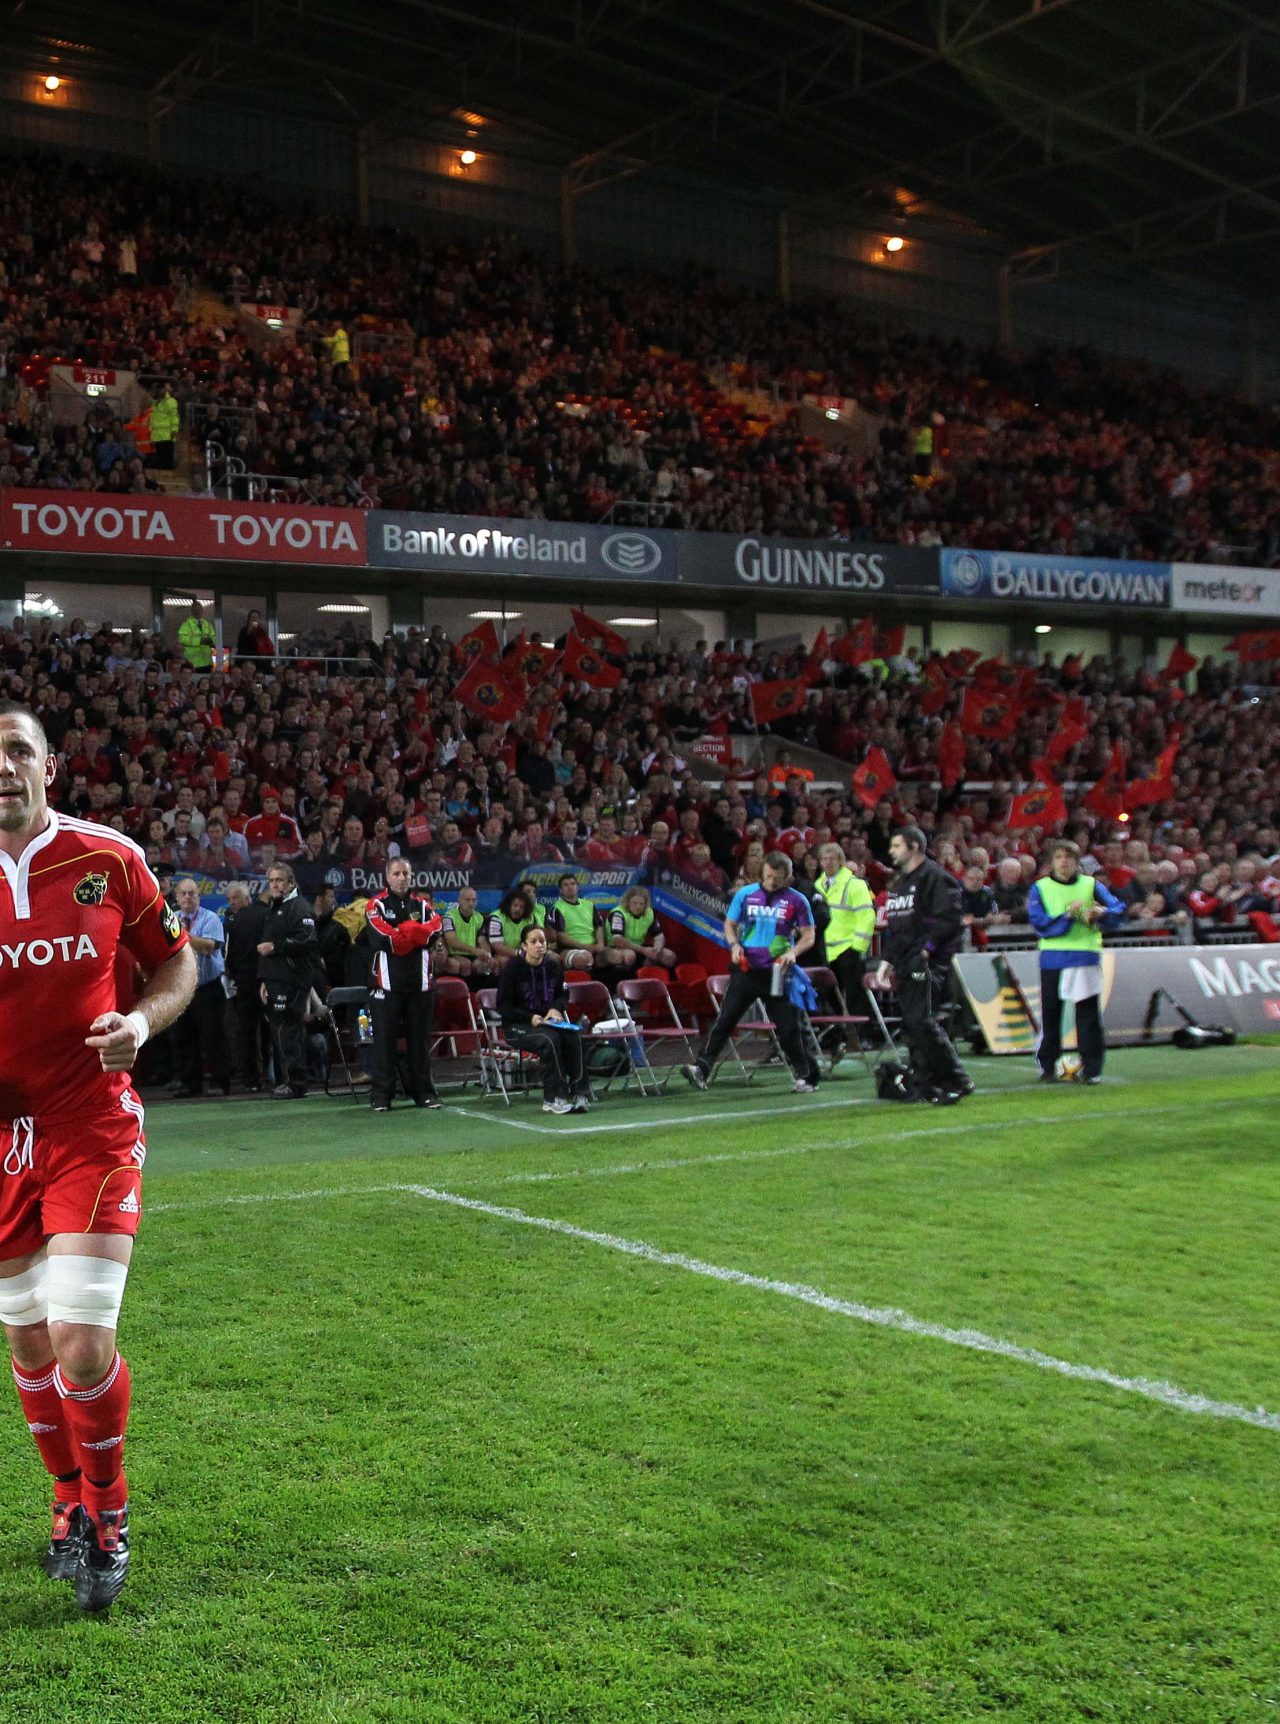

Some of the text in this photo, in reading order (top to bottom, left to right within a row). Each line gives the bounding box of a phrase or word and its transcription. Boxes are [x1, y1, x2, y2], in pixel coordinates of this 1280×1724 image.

[85, 373, 106, 384] 211
[12, 502, 174, 542] TOYOTA
[209, 513, 359, 552] TOYOTA
[382, 523, 587, 564] Bank of Ireland
[734, 537, 886, 590] GUINNESS
[990, 556, 1166, 603] BALLYGOWAN
[1183, 577, 1265, 603] meteor
[351, 867, 471, 890] BALGOWAN
[672, 873, 729, 914] BALLYGOWAN
[747, 904, 788, 920] RWE
[1187, 956, 1280, 998] MAG
